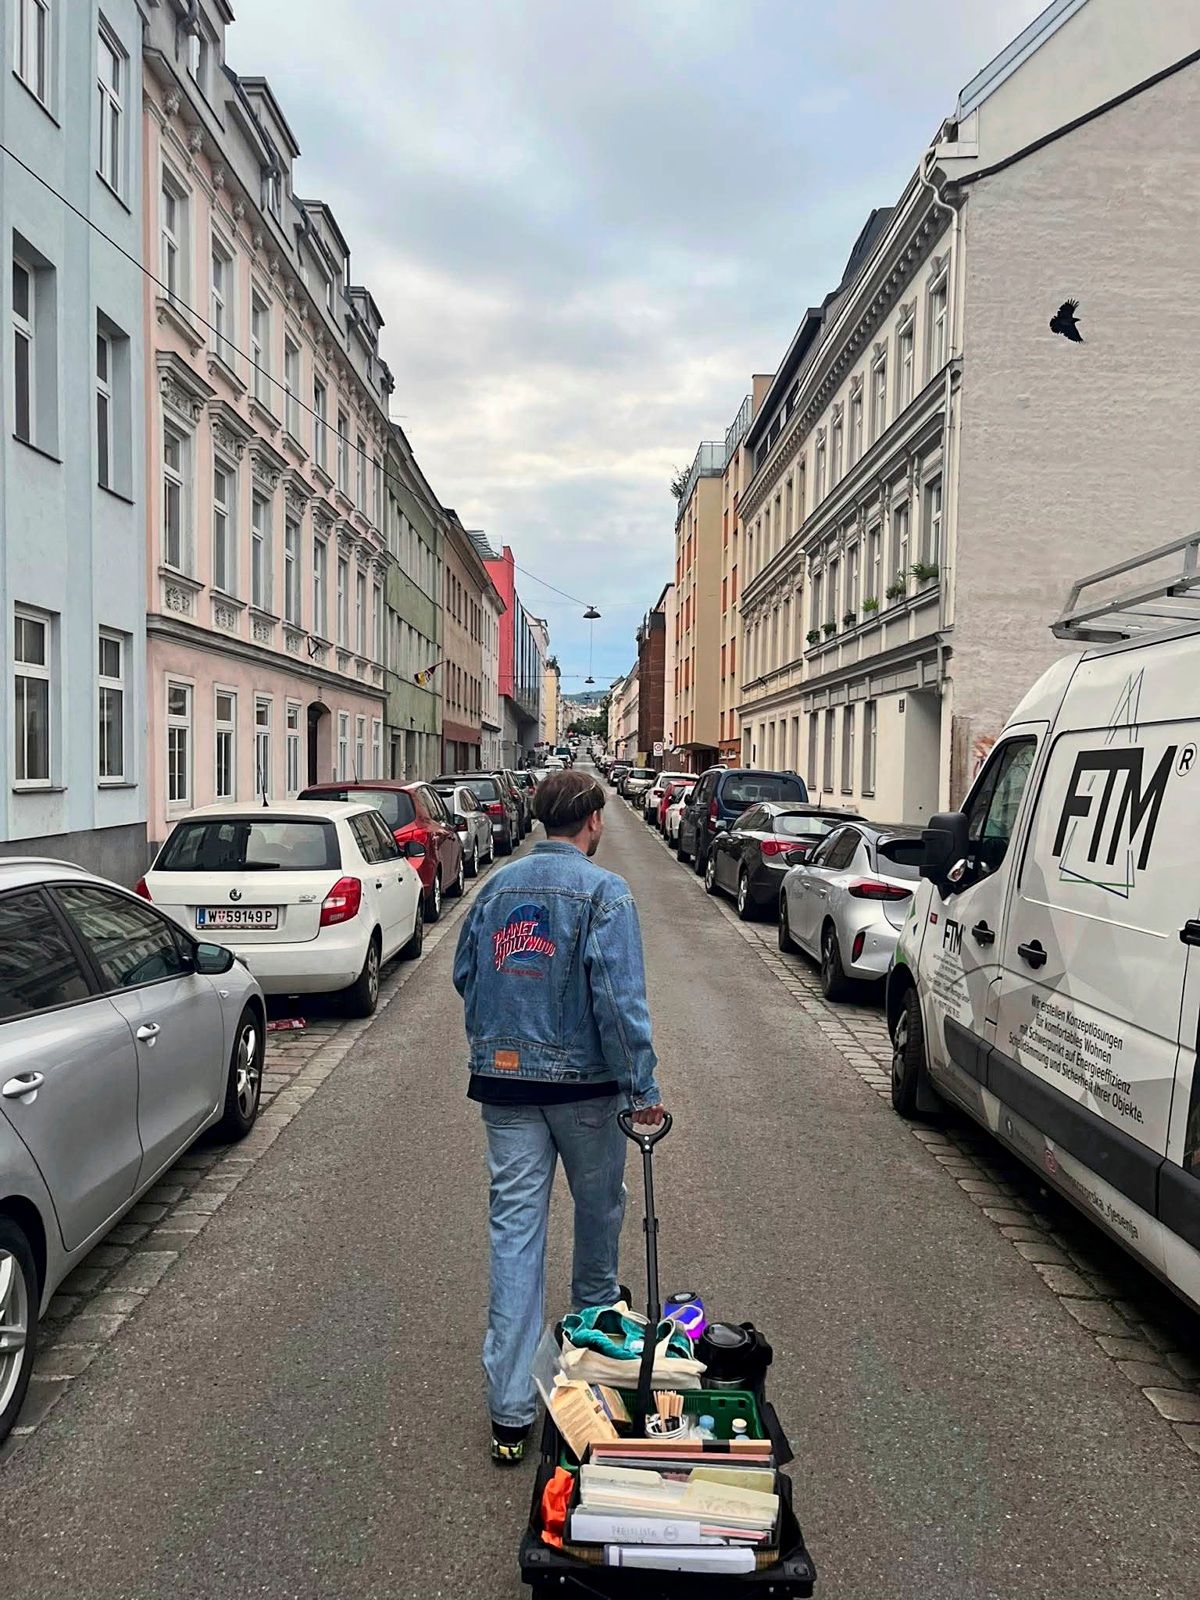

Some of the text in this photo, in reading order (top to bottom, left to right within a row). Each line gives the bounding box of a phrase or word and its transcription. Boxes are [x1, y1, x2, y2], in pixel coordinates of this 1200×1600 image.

[1052, 745, 1178, 871] FTM
[208, 910, 273, 922] W 59149 P
[493, 921, 539, 955] PLANET
[495, 936, 556, 971] HOLLYWOOD
[943, 918, 964, 956] FTM
[1065, 1010, 1124, 1051] Konzeptlösungen
[1084, 1037, 1112, 1065] Wohnen
[1064, 1048, 1076, 1063] auf
[1075, 1051, 1132, 1096] Energieeffizienz
[1049, 1058, 1061, 1074] und
[1061, 1062, 1093, 1094] Sicherheit
[1112, 1092, 1144, 1125] Objekte.
